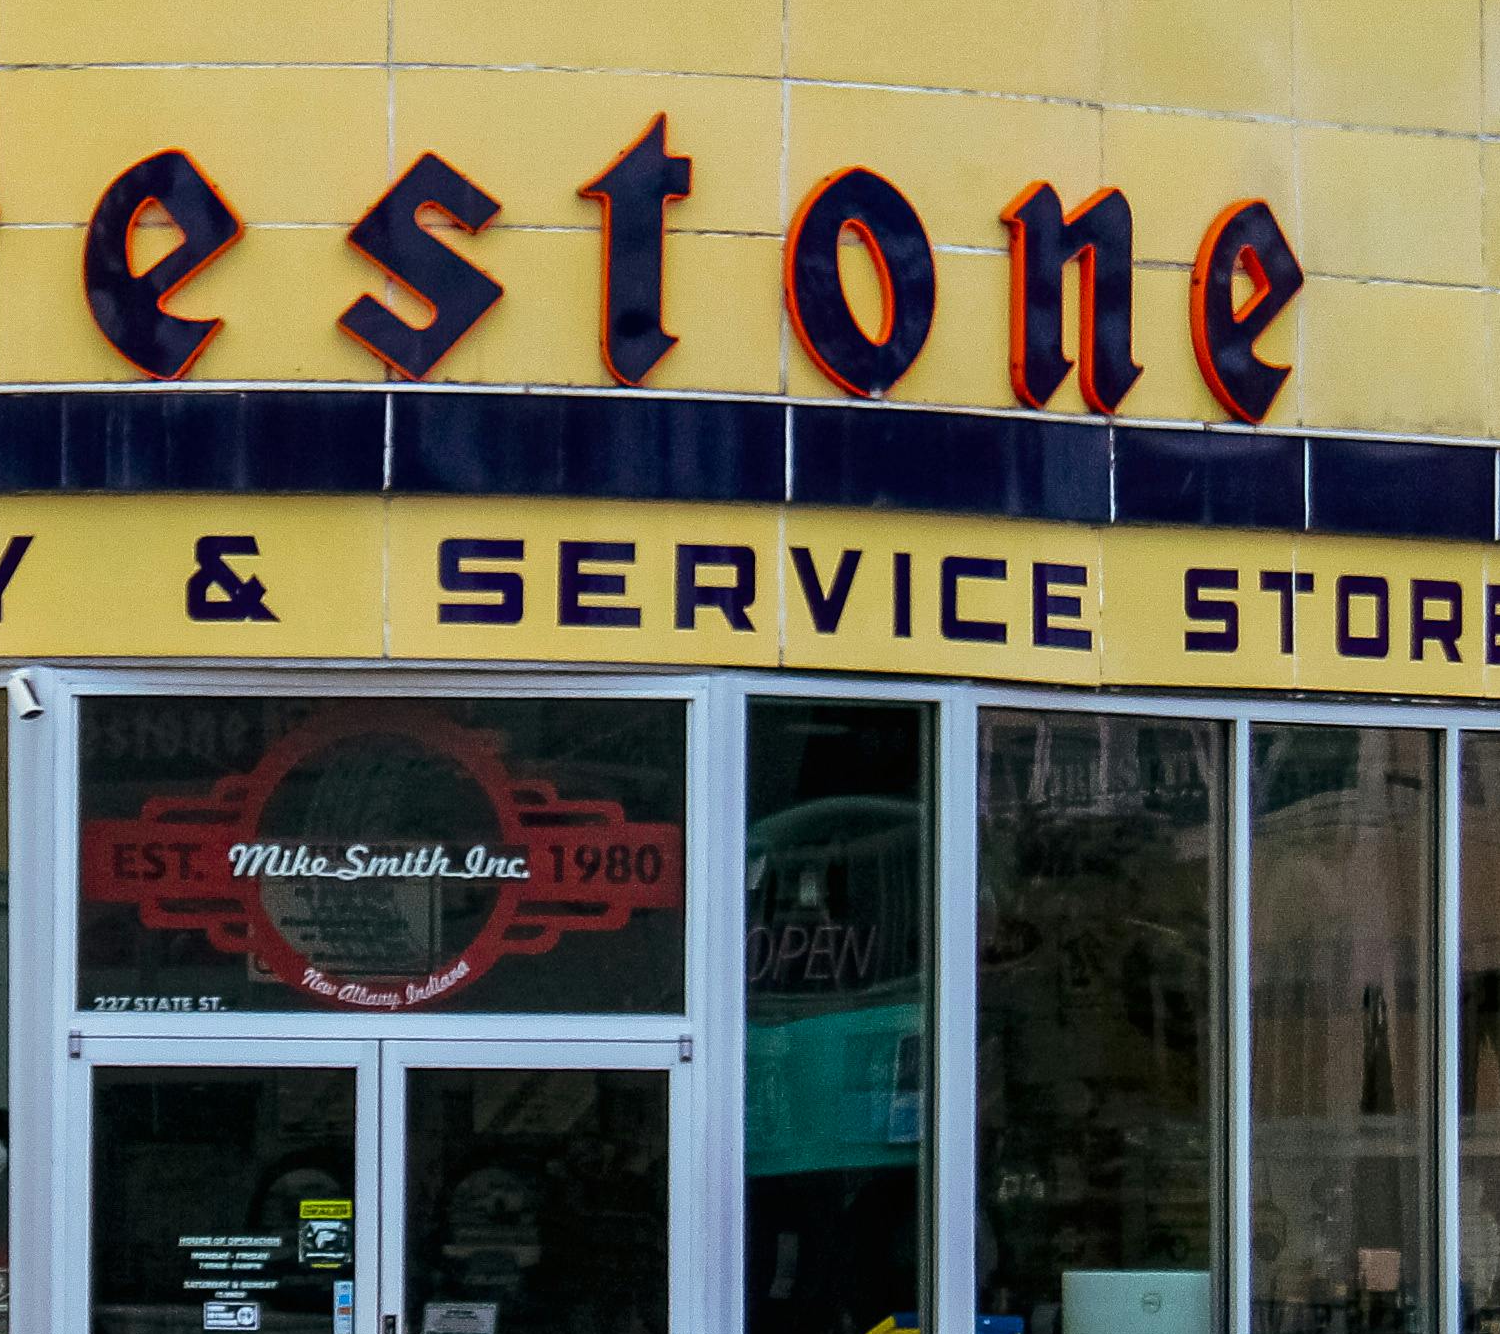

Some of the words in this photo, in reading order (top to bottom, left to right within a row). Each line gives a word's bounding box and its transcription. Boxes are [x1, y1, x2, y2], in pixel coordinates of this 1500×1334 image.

[185, 534, 282, 624] &
[435, 537, 1095, 651] SERVICE
[228, 843, 334, 879] Mike
[336, 843, 452, 881] Smith
[452, 845, 530, 879] Inc.
[548, 844, 662, 885] 1980
[93, 996, 131, 1012] 227
[133, 996, 193, 1012] STATE
[198, 996, 227, 1012] ST.
